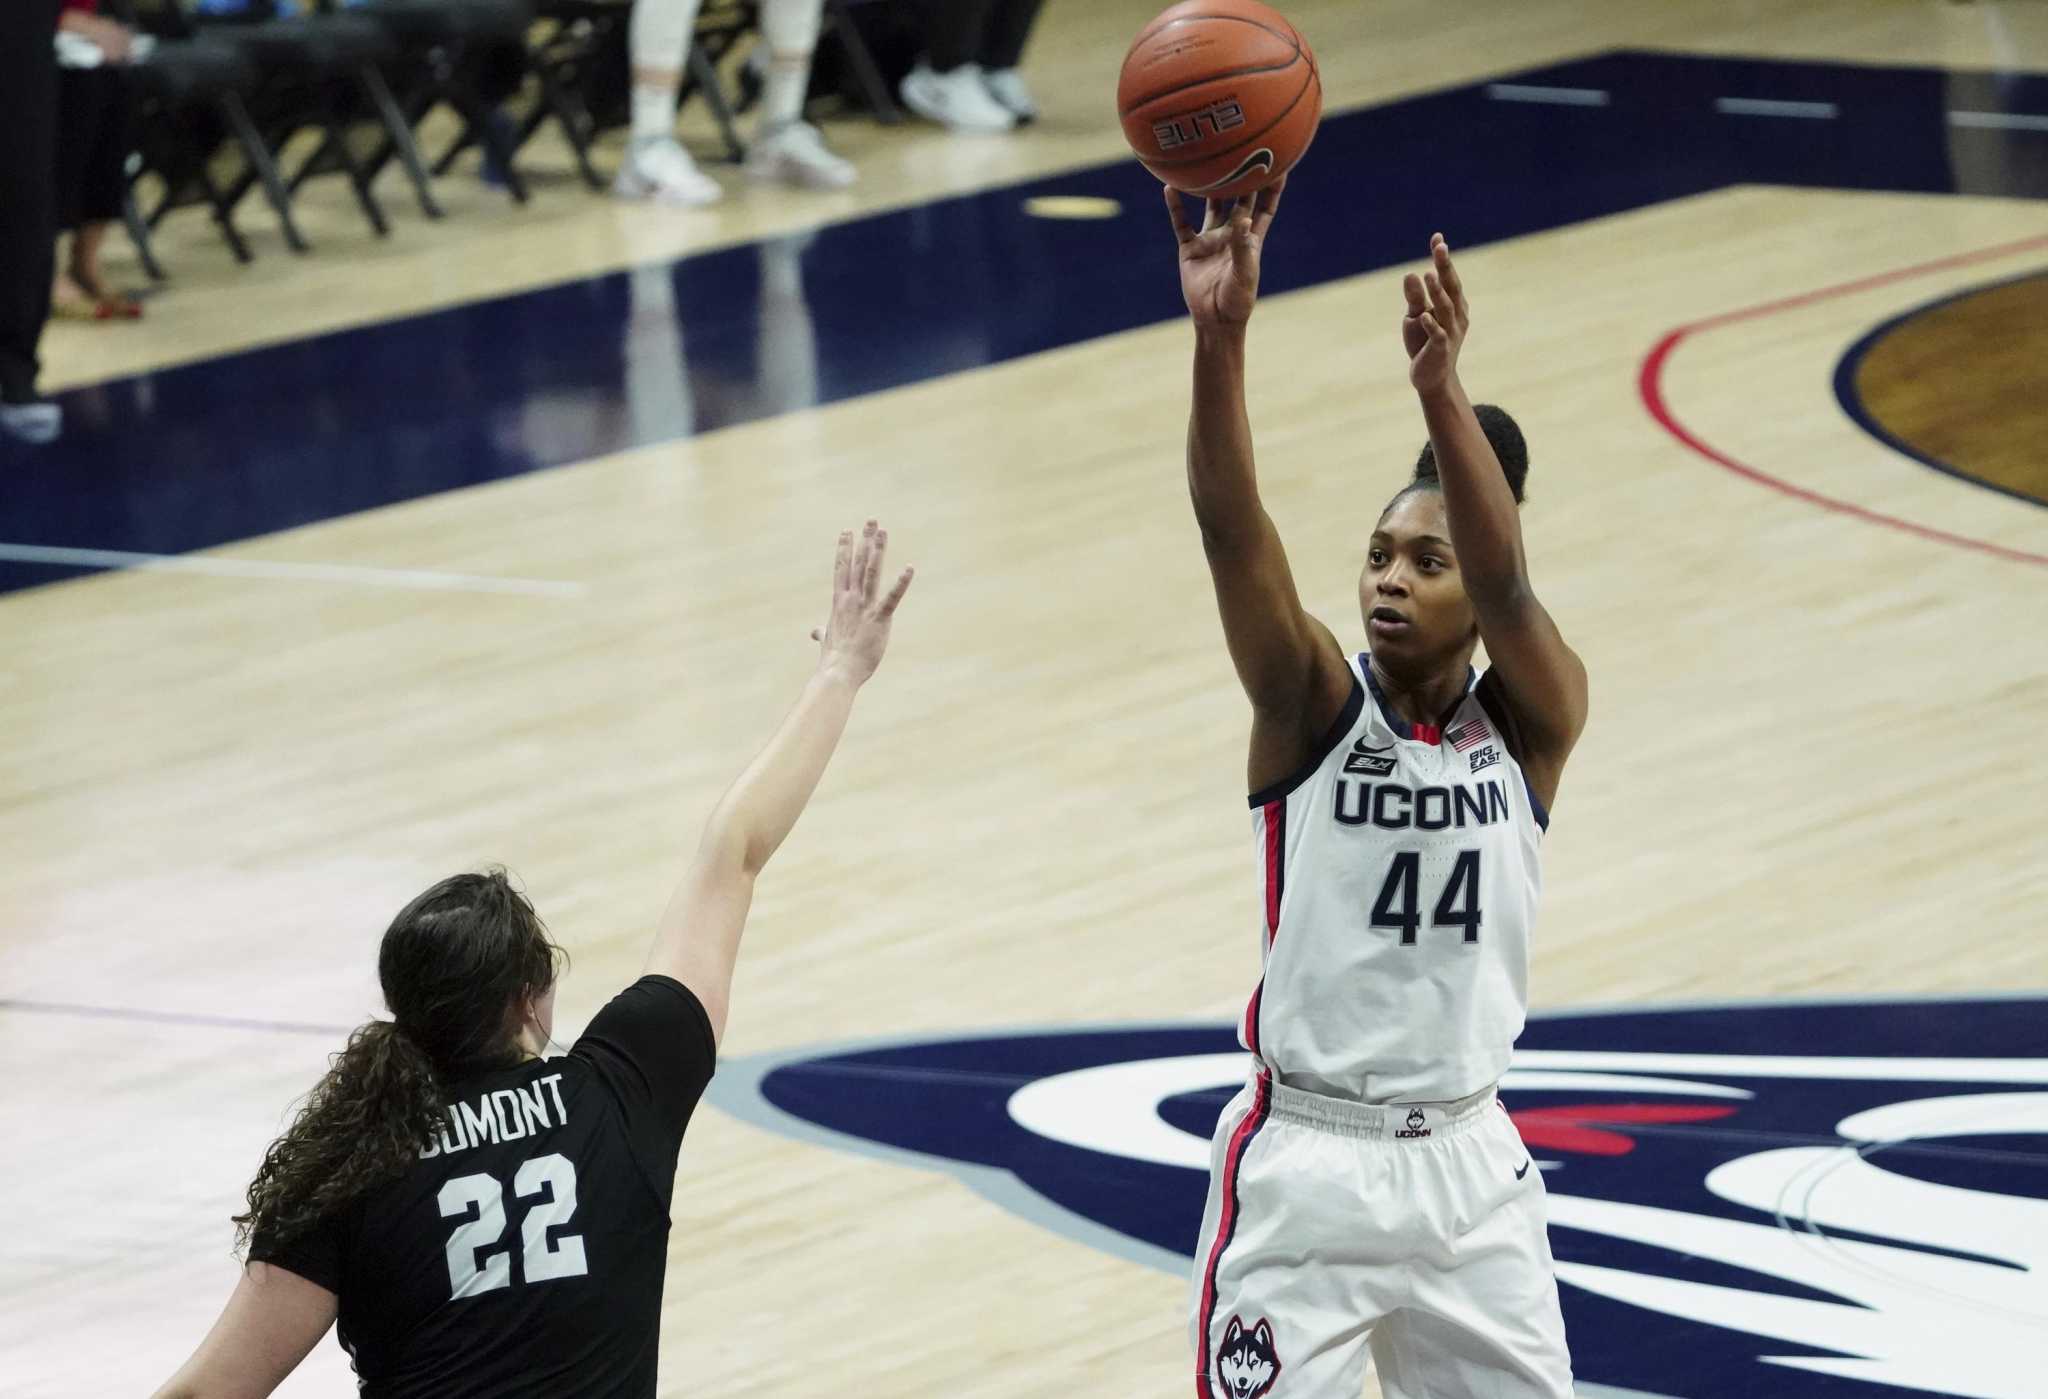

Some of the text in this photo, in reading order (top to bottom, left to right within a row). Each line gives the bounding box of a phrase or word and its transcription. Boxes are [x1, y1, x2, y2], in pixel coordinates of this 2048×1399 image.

[1470, 745, 1493, 761] BIG
[1470, 752, 1501, 769] EAST
[1334, 779, 1509, 830] UCONN
[1368, 848, 1483, 946] 44
[1395, 1128, 1431, 1138] UCONN
[437, 1152, 588, 1301] 22
